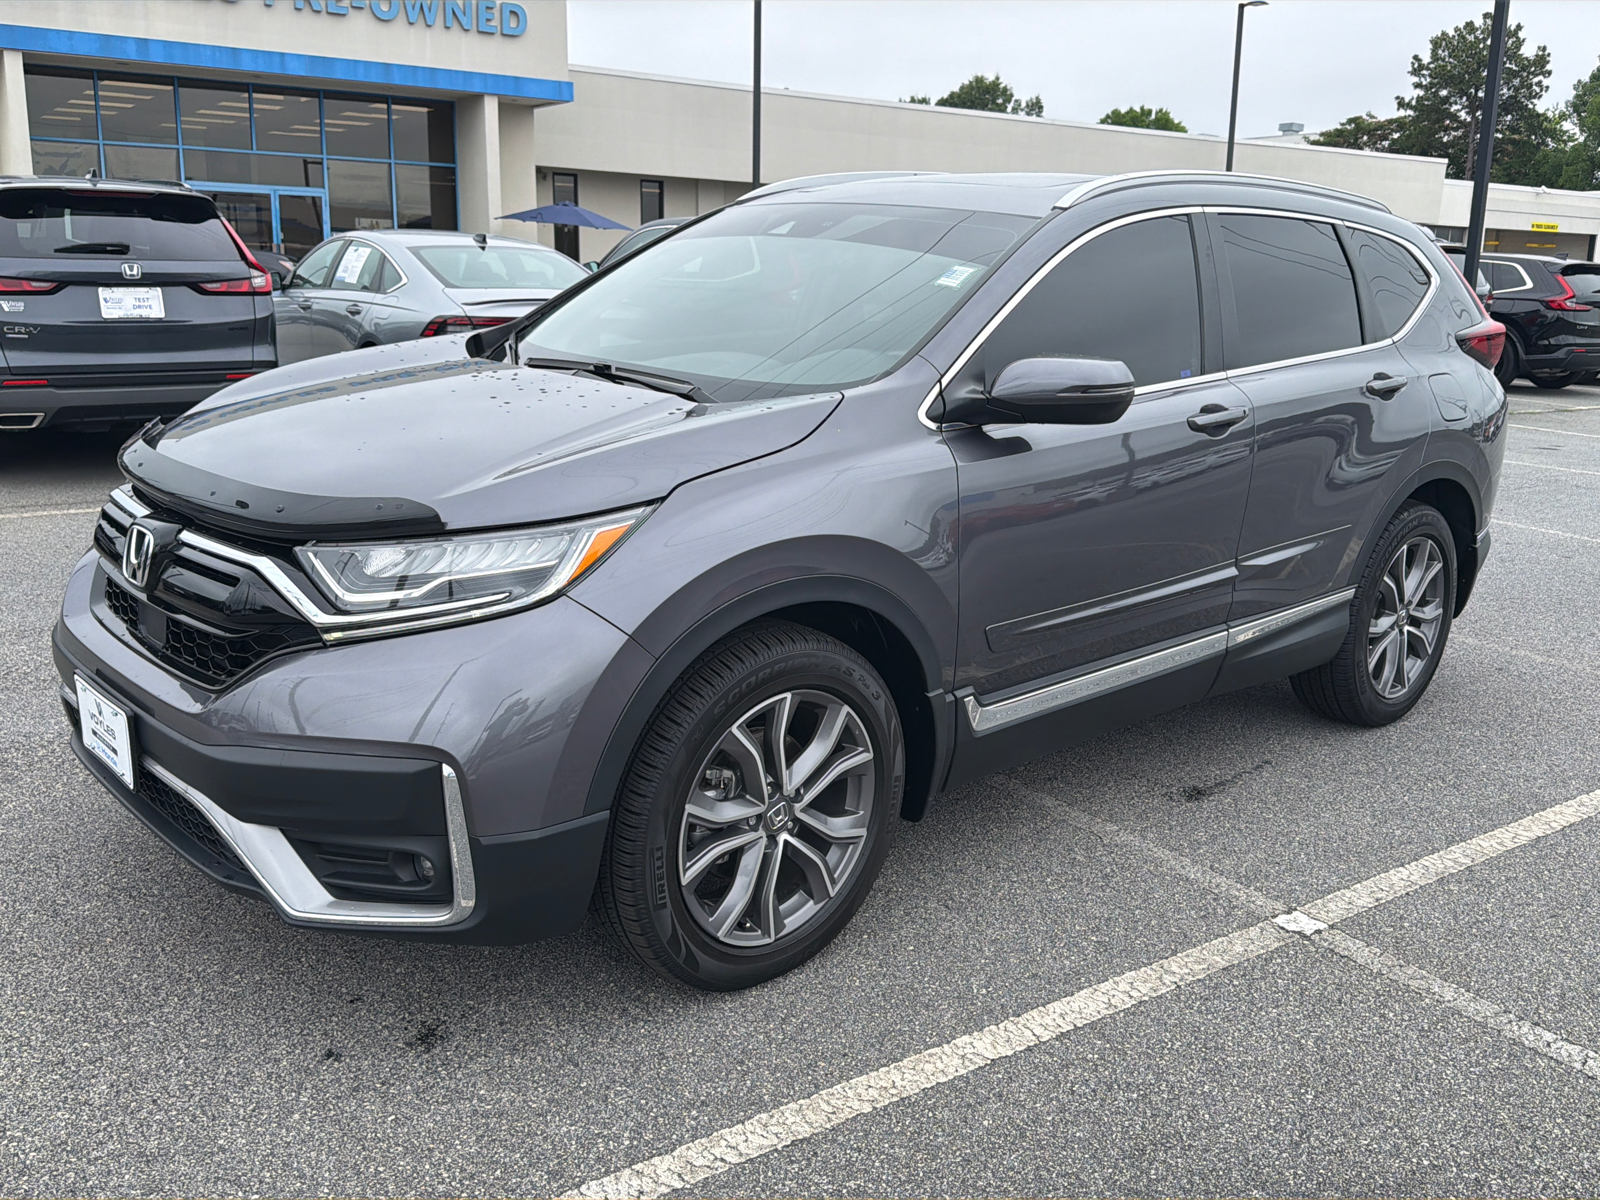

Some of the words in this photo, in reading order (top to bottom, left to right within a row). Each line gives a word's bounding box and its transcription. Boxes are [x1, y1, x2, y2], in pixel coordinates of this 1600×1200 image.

[264, 0, 528, 36] -OWNED
[4, 325, 41, 334] CR-V
[713, 657, 819, 716] SCORPION
[828, 661, 856, 678] AS
[857, 674, 871, 690] Plus
[871, 689, 882, 701] 3
